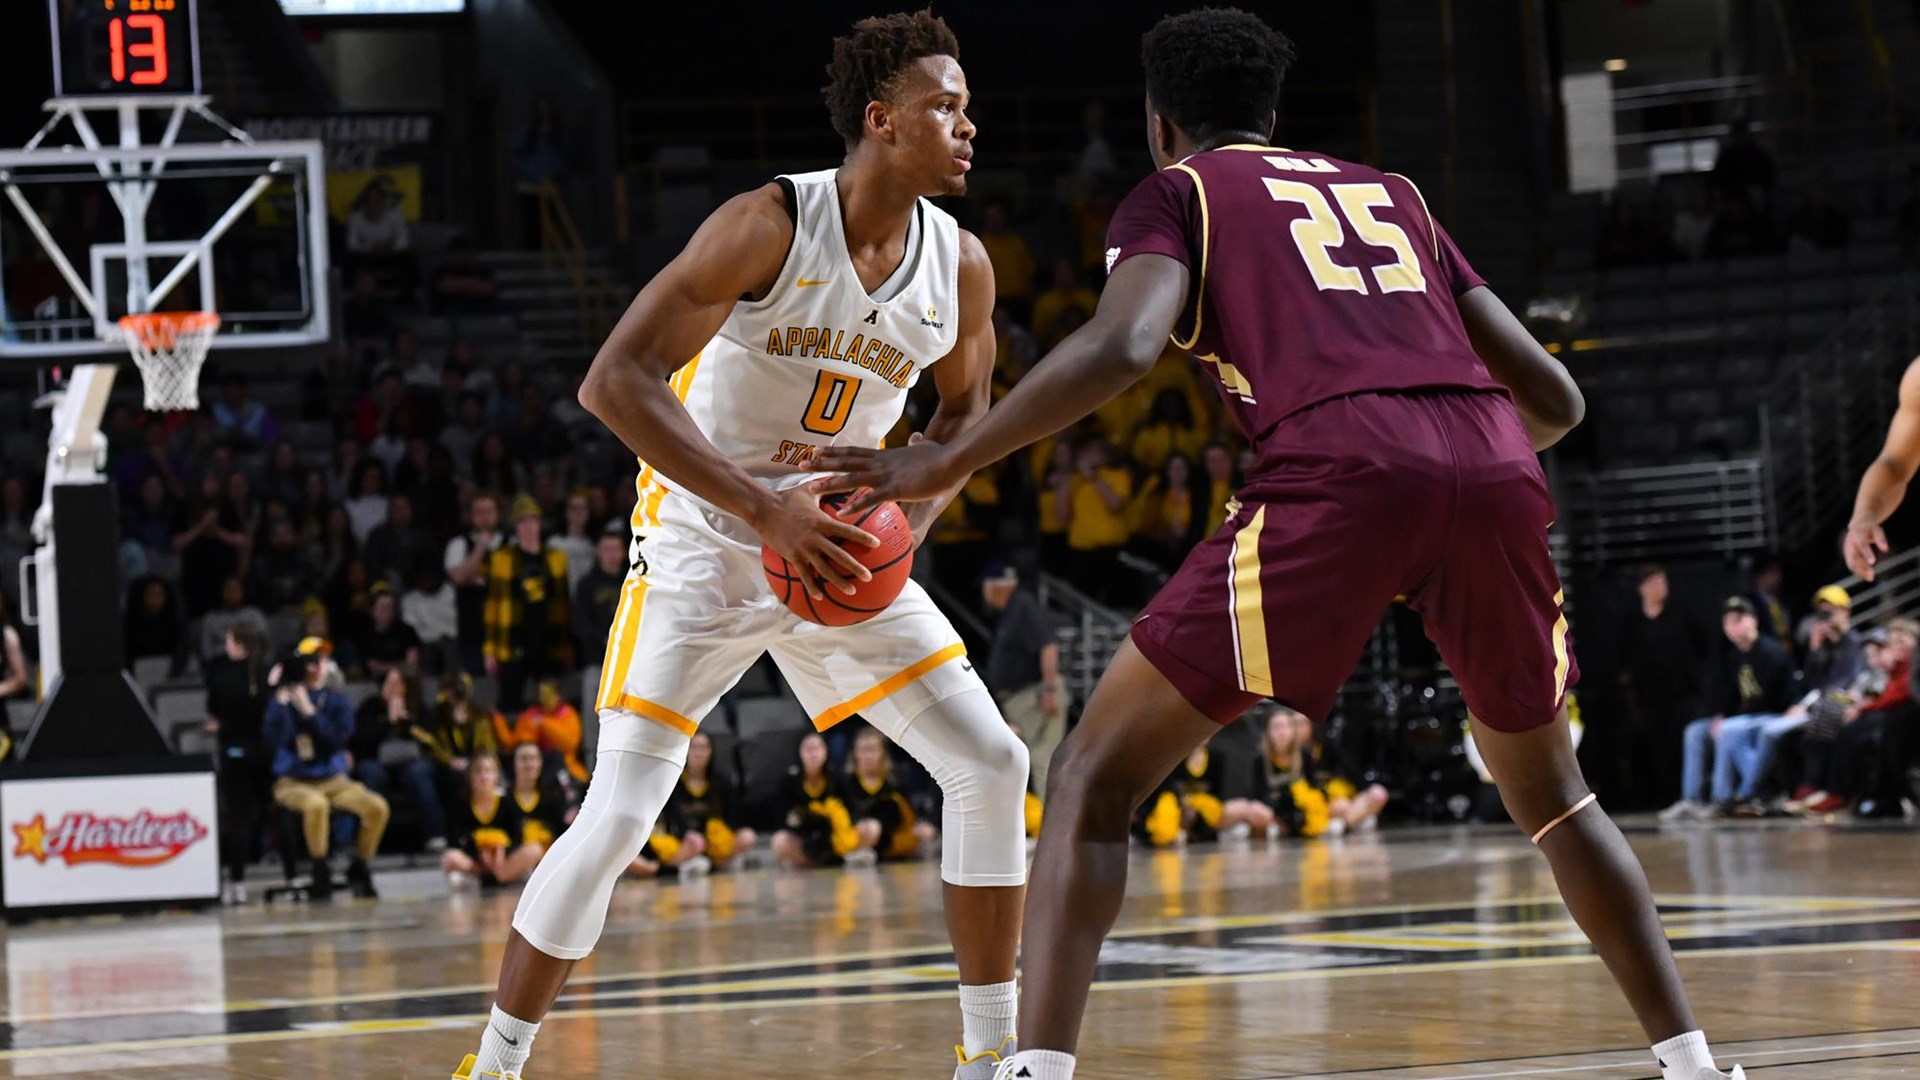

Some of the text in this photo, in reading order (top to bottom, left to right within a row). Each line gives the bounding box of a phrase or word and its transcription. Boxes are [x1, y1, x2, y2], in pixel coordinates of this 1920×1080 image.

[109, 14, 168, 85] 13
[1261, 176, 1427, 295] 25
[863, 309, 879, 325] A
[767, 326, 916, 389] APPALACHIA
[800, 369, 862, 436] 0
